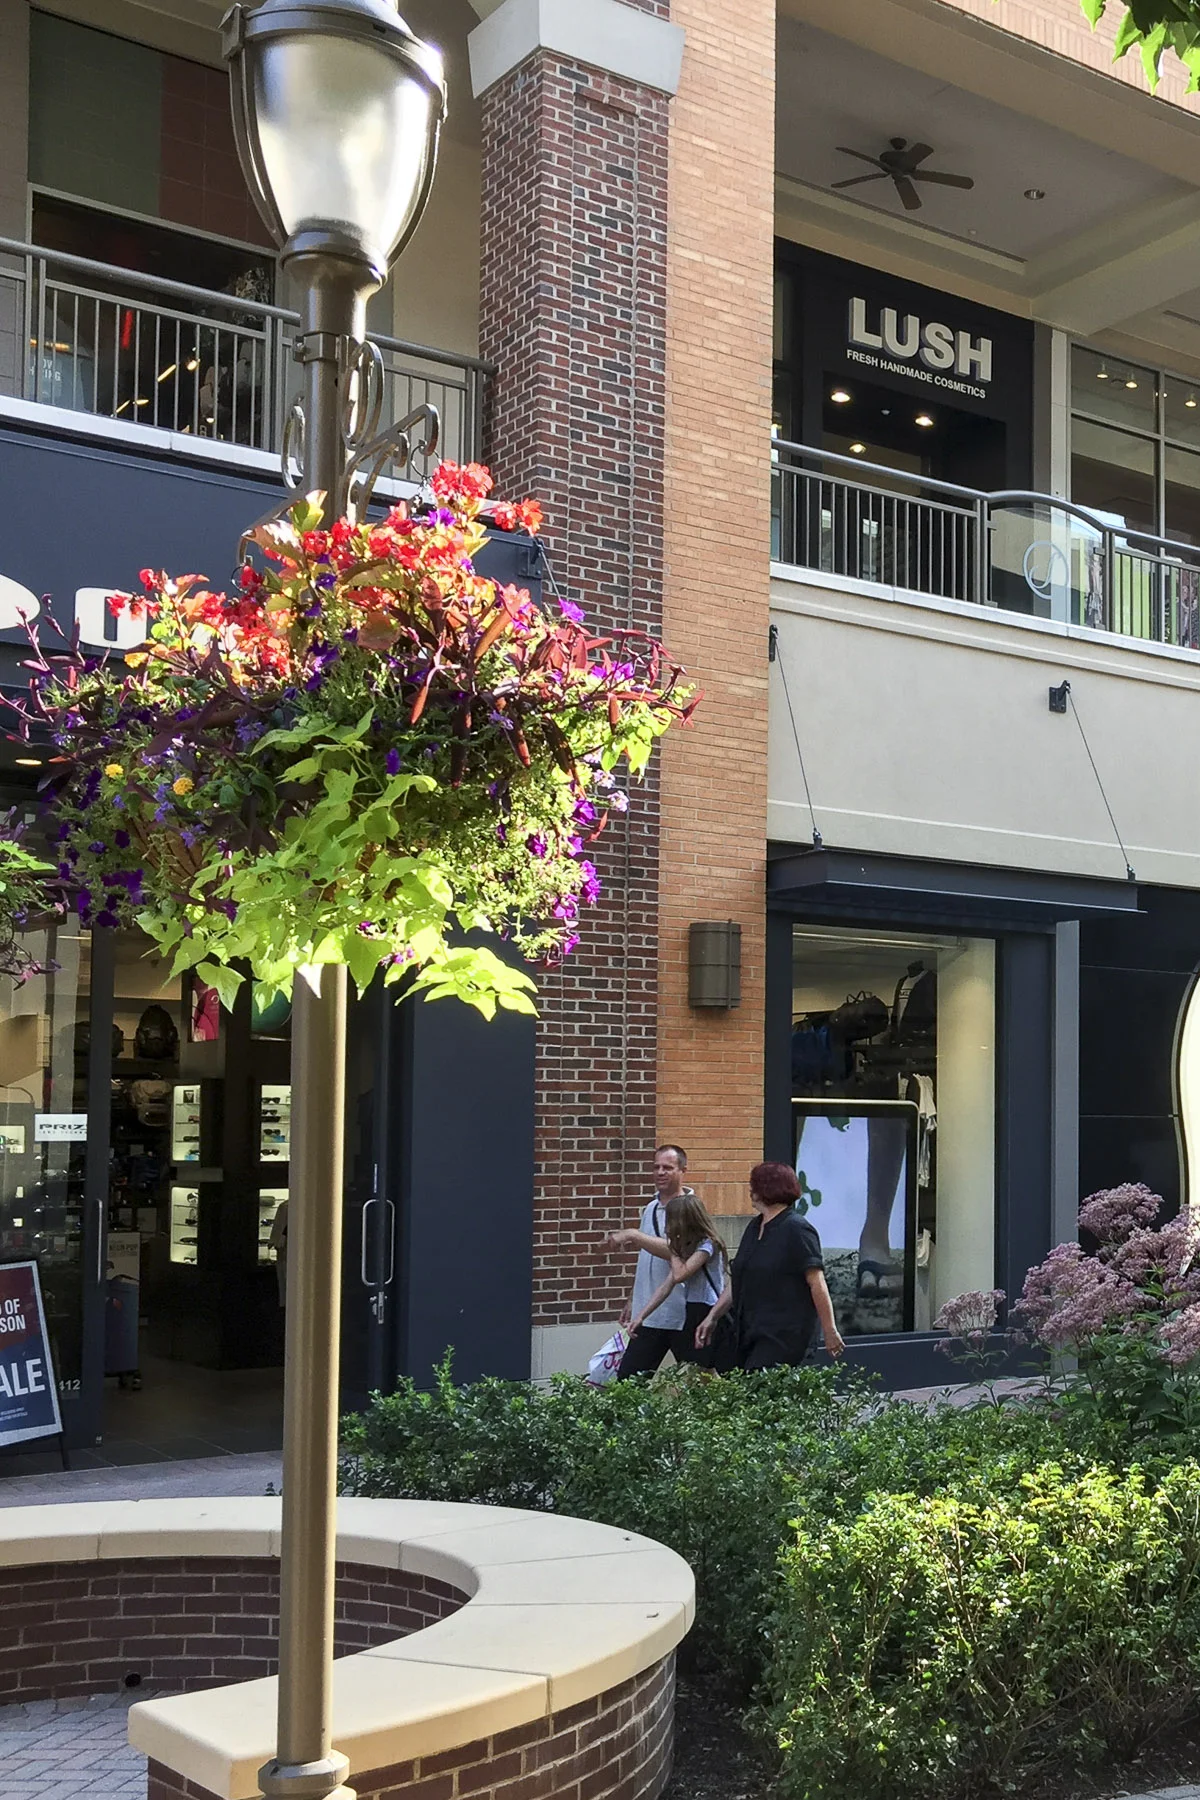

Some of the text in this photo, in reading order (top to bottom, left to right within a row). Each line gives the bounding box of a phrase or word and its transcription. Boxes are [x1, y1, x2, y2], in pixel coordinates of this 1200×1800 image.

[849, 296, 992, 382] LUSH
[846, 349, 986, 399] FRESH HANDMADE COSMETICS
[5, 1298, 21, 1315] OF
[0, 1357, 46, 1398] ALE
